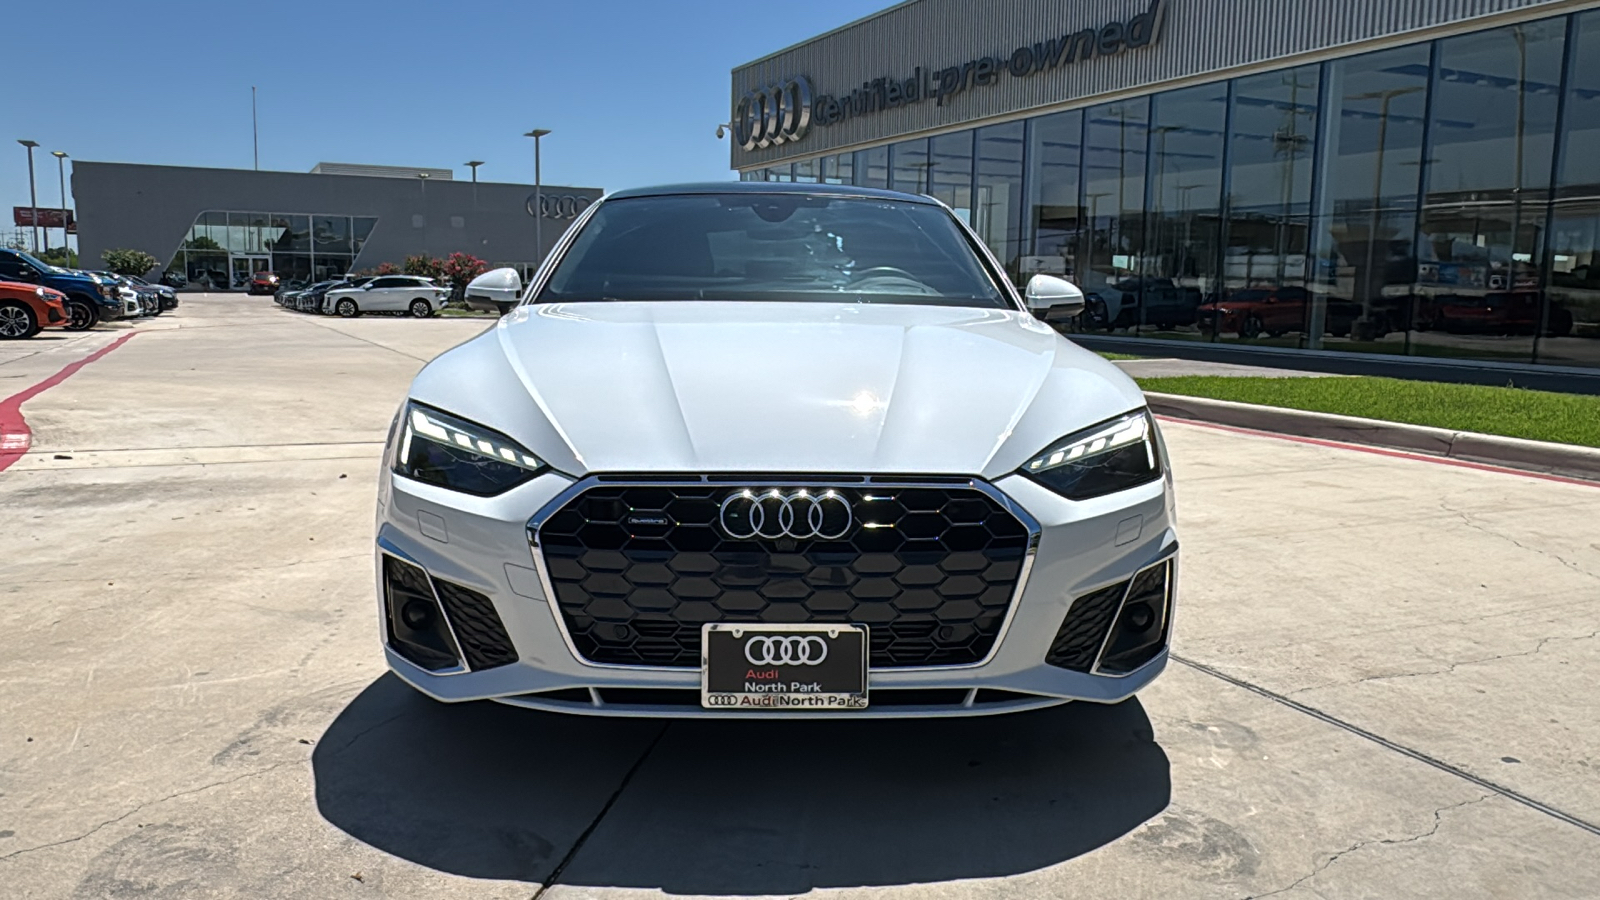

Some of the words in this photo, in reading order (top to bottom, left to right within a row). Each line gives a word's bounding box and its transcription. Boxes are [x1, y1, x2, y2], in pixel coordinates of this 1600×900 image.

[813, 66, 924, 126] Certified
[745, 669, 779, 679] Audi
[744, 682, 787, 692] North
[791, 682, 822, 692] Park
[740, 695, 776, 706] Audi
[779, 695, 825, 706] North
[828, 695, 862, 706] Park
